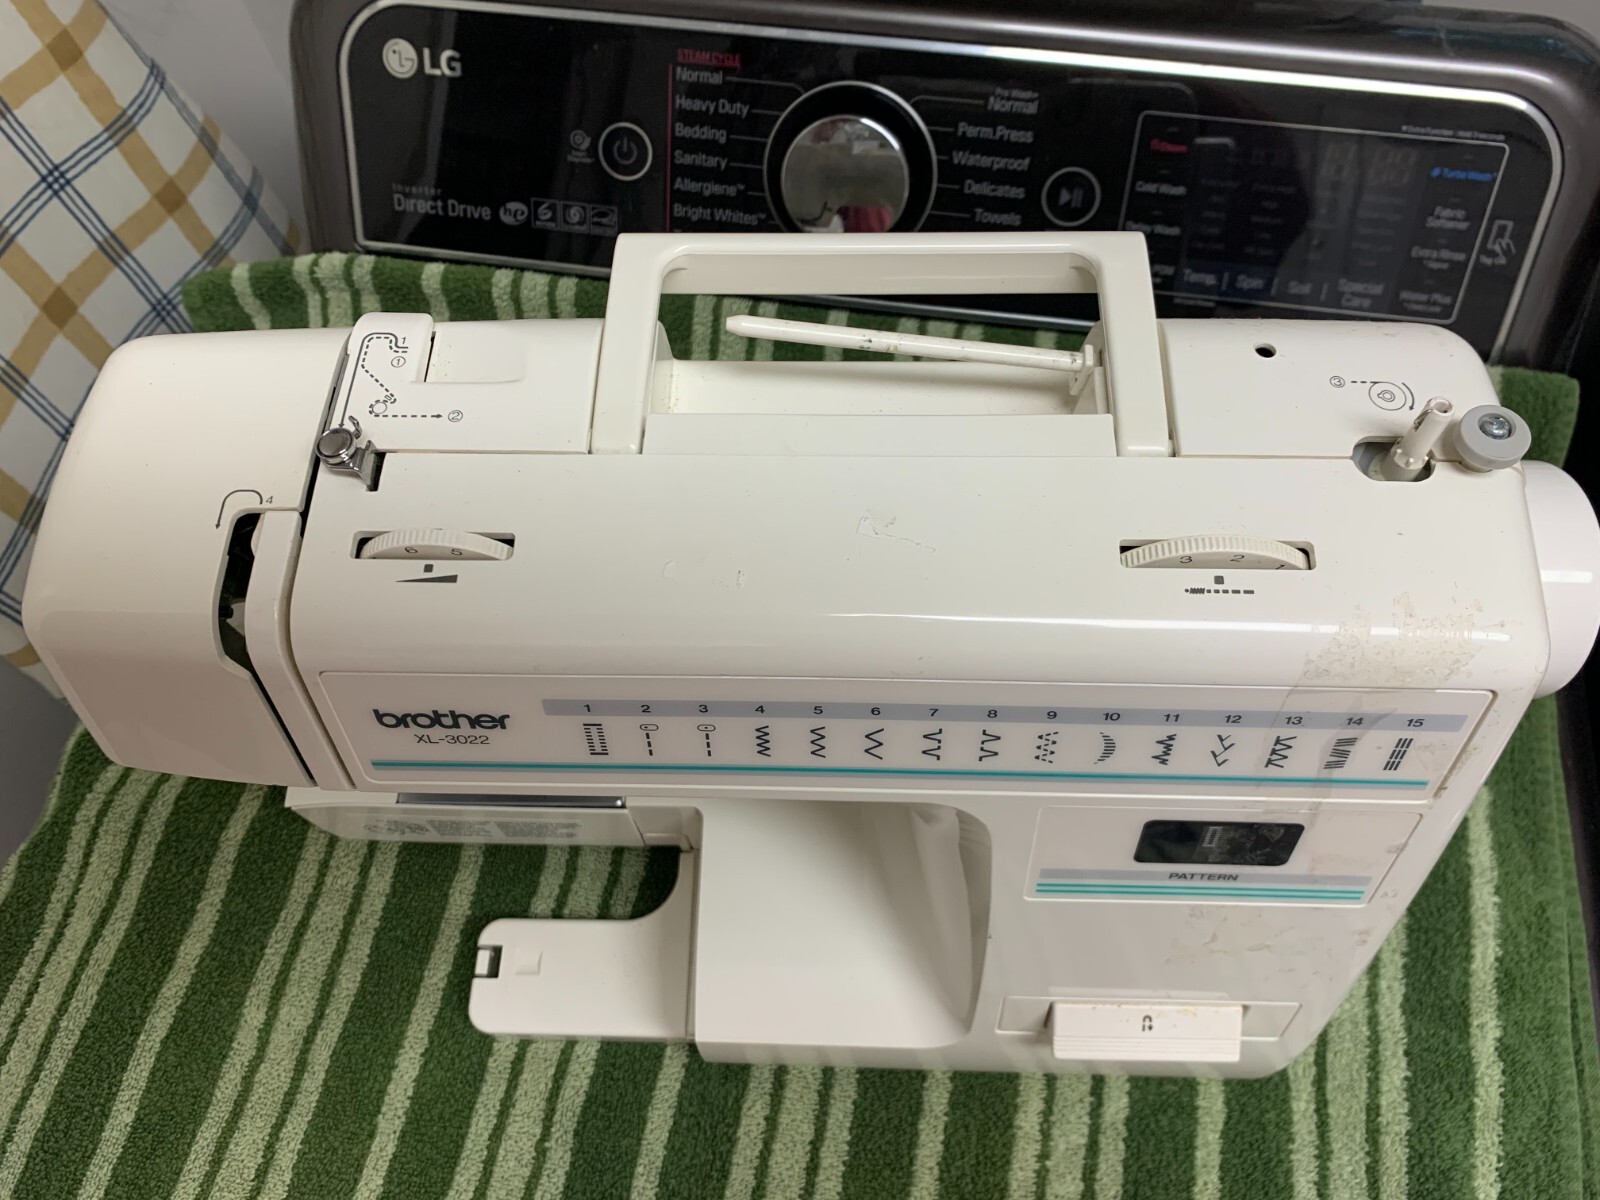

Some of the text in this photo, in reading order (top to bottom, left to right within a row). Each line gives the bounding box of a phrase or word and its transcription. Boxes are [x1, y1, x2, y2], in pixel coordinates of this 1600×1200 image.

[422, 47, 463, 78] LG
[675, 66, 723, 85] Normal
[674, 94, 750, 119] Heavy Duty
[987, 96, 1039, 115] Normal
[674, 122, 727, 144] Bedding
[673, 149, 728, 171] Sanitary
[952, 149, 1031, 172] Waterproof
[963, 178, 1026, 200] Delicates
[393, 192, 445, 216] Direct
[447, 198, 492, 221] Drive
[673, 203, 712, 223] Bright
[973, 207, 1022, 227] Towels
[265, 494, 274, 505] 4
[404, 546, 463, 556] 6 5
[1179, 555, 1193, 564] 3
[1230, 554, 1245, 563] 2
[372, 708, 511, 731] brother
[583, 704, 1425, 728] 1 2 3 4 5 6 7 8 9 10 11 12 13 14 15
[413, 733, 491, 746] XL-3022
[1168, 872, 1239, 882] PATTERN
